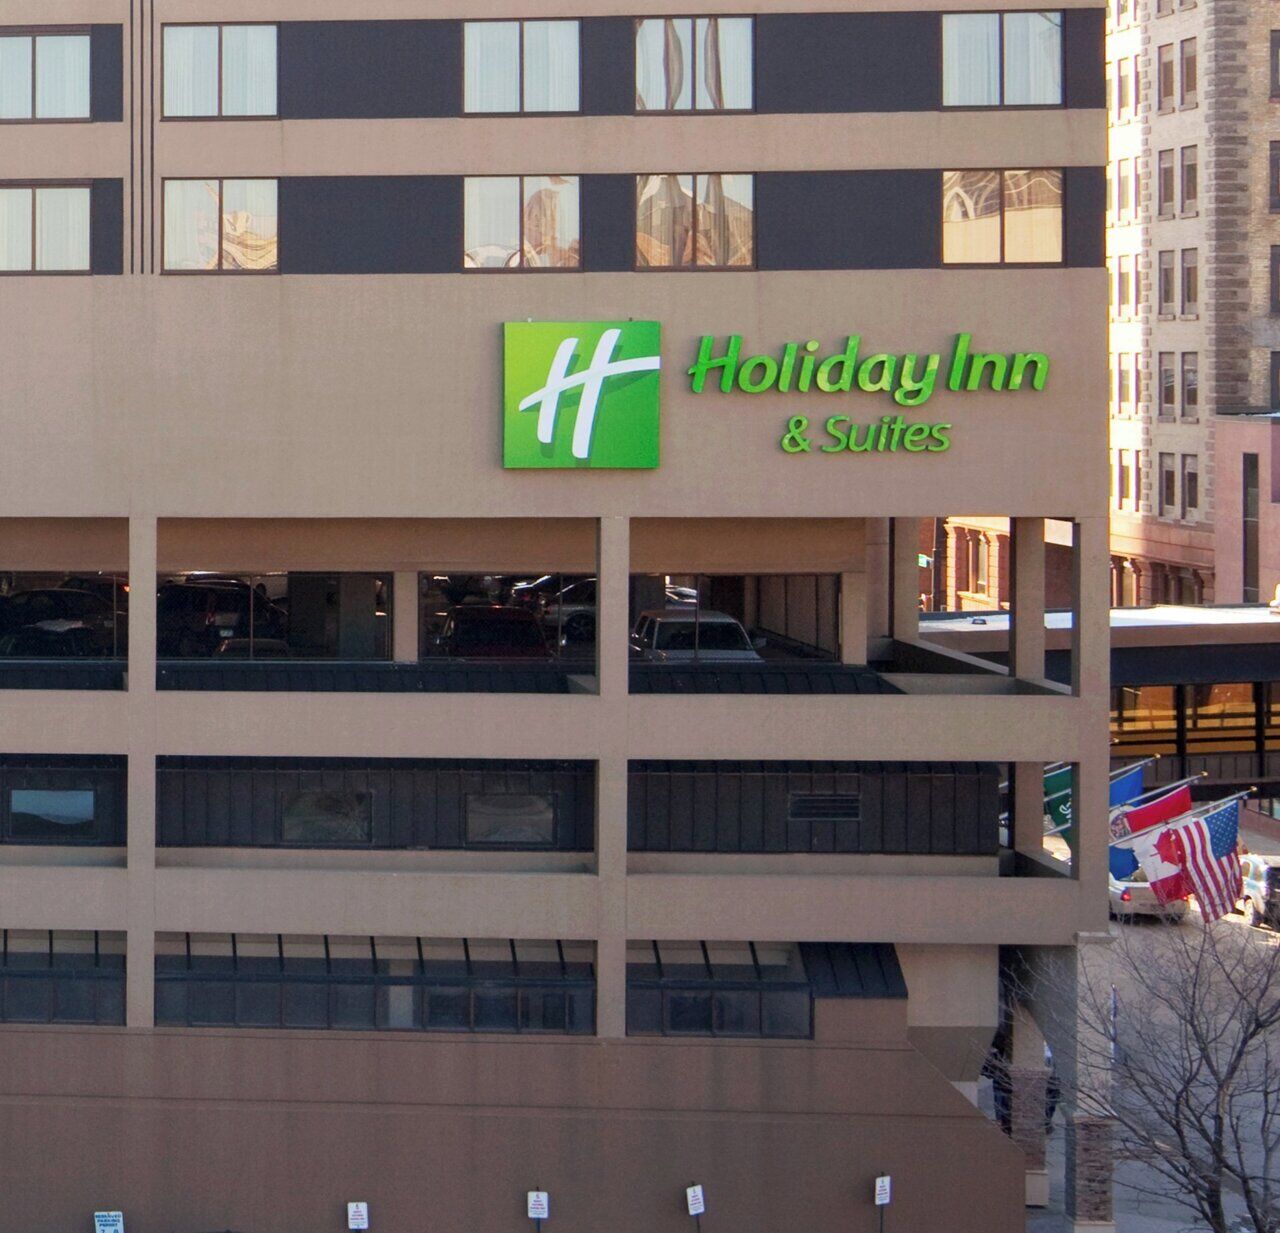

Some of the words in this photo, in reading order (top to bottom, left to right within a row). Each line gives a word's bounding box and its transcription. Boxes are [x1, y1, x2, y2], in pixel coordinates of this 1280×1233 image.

[688, 334, 940, 407] Holiday
[949, 333, 1049, 392] Inn
[781, 415, 811, 454] &
[821, 415, 951, 453] Suites
